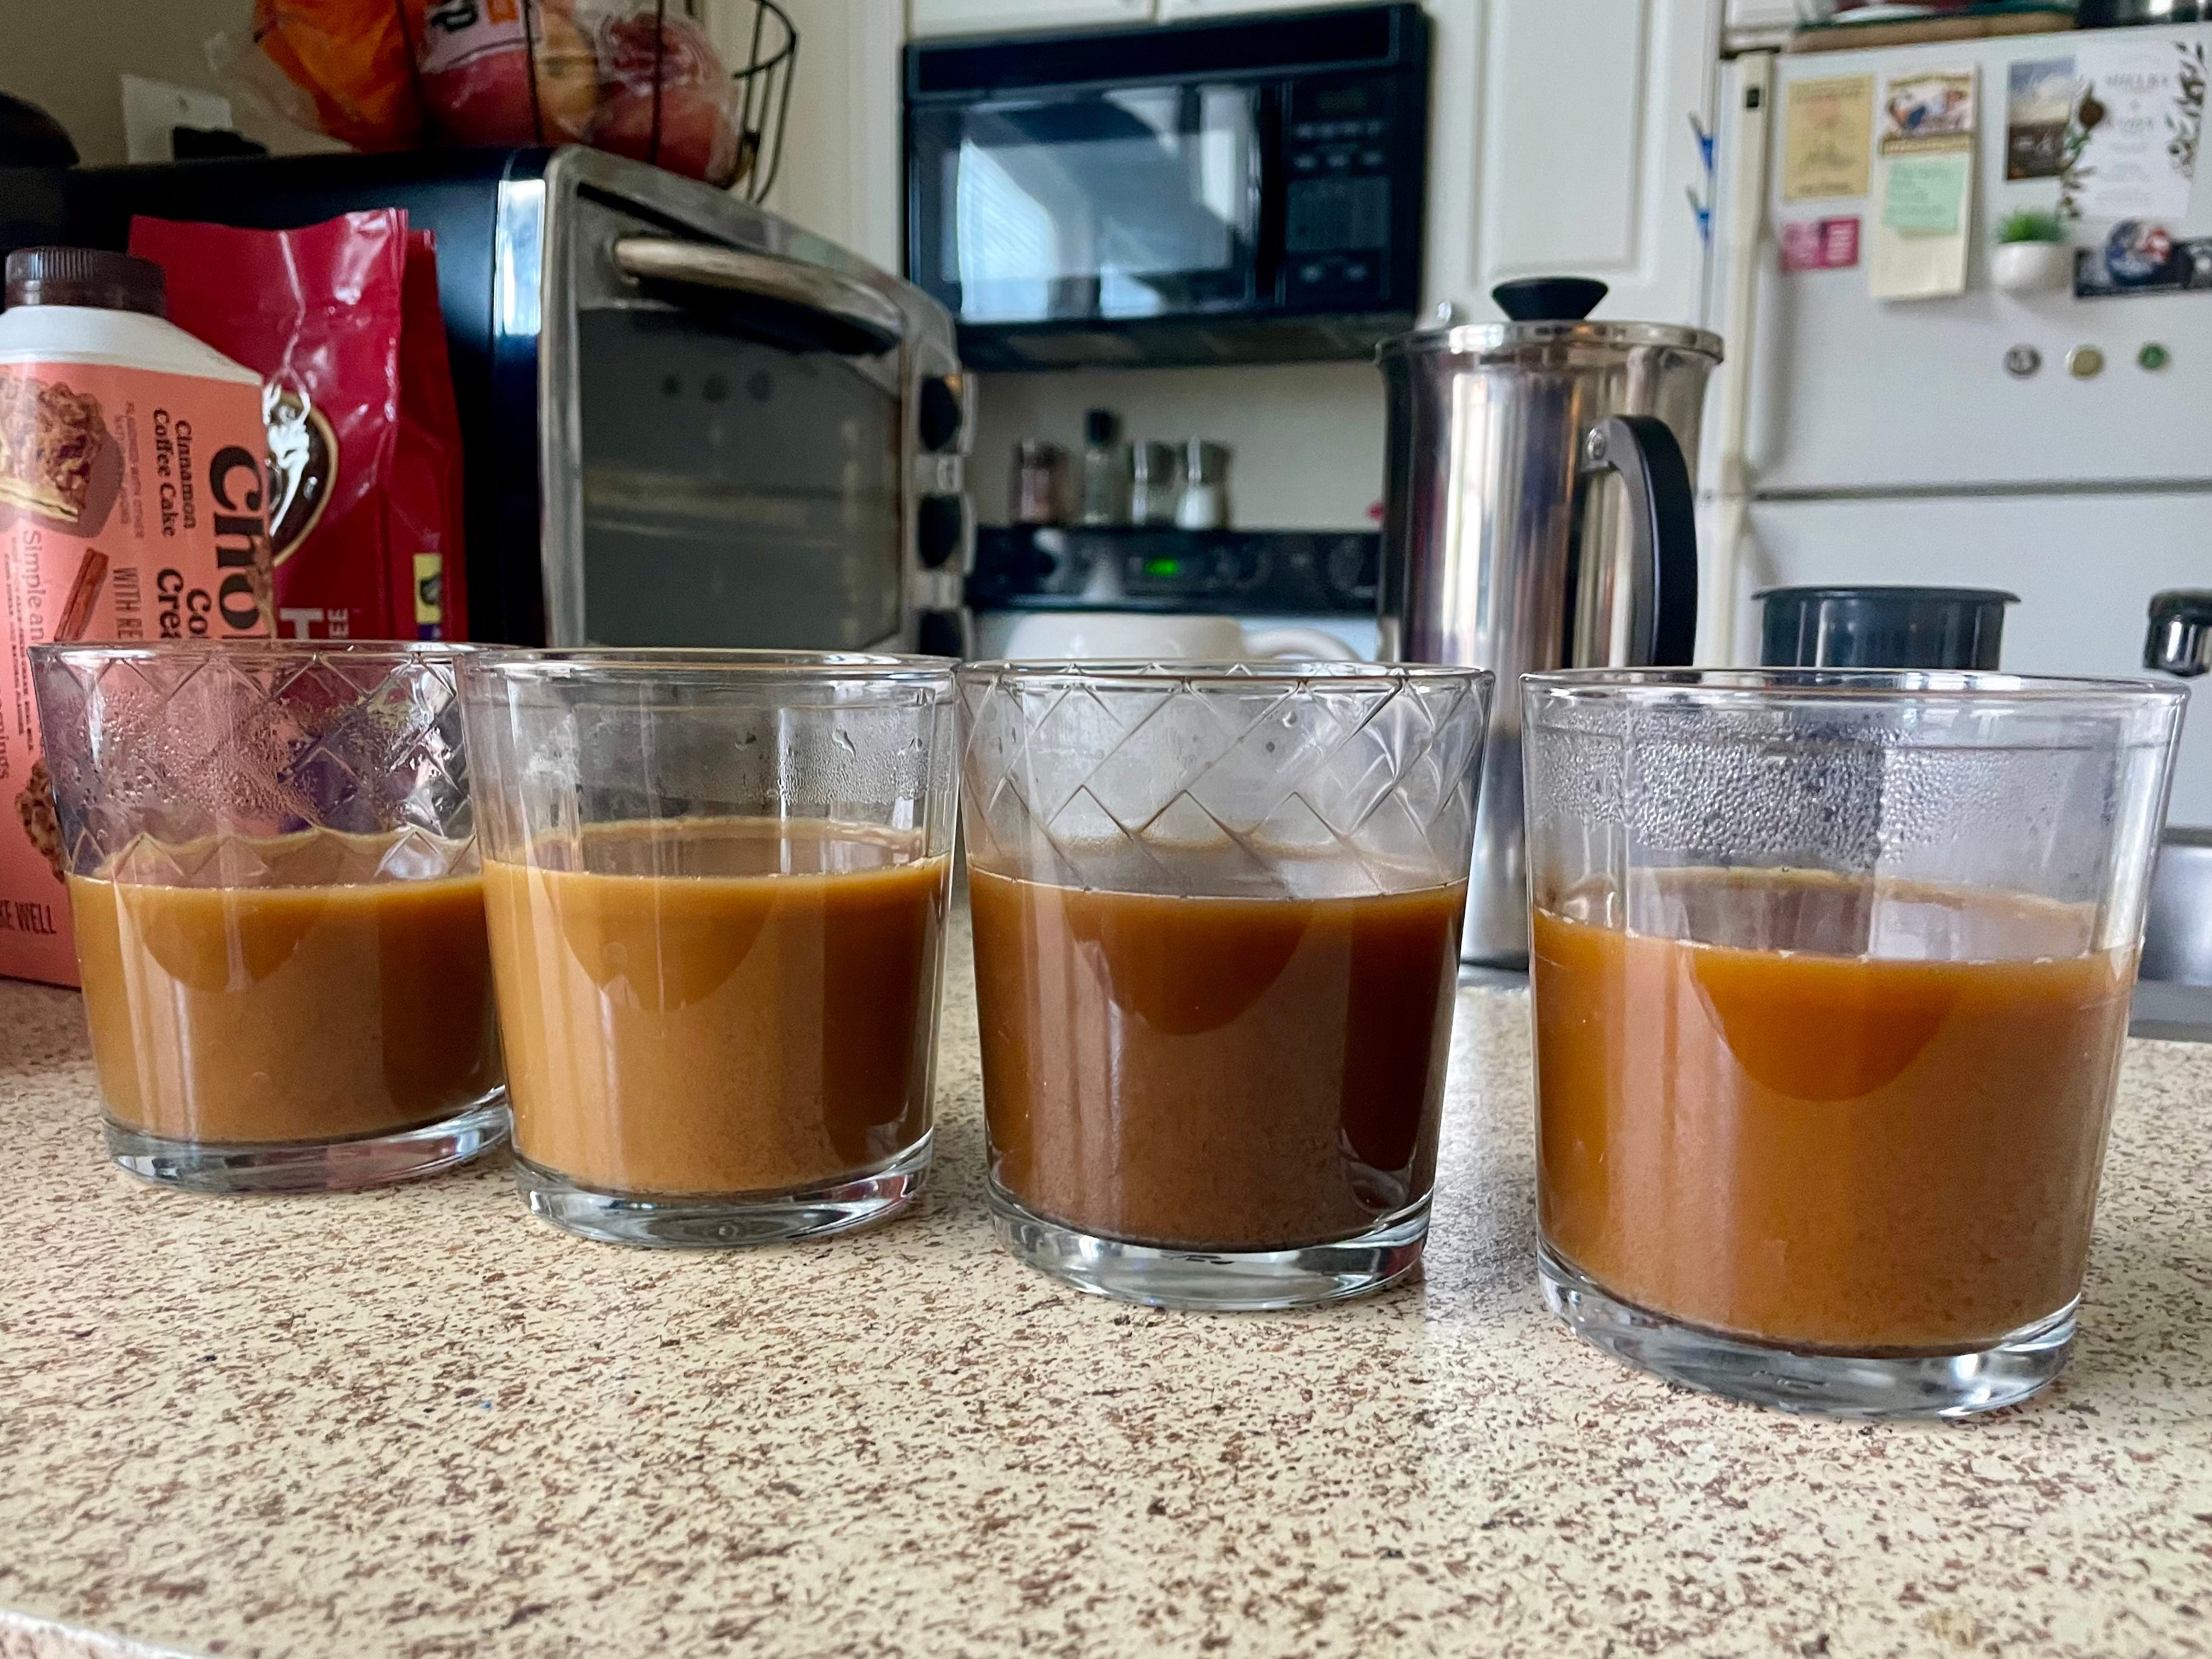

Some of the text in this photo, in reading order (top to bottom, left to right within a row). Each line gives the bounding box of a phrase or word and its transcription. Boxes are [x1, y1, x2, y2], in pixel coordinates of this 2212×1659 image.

[154, 408, 179, 536] Coffee Cake
[175, 420, 196, 529] Cinnamon
[23, 530, 46, 608] Simple
[209, 445, 270, 639] Cho
[113, 567, 141, 611] WITH
[186, 588, 212, 639] Co
[14, 901, 57, 934] WELL
